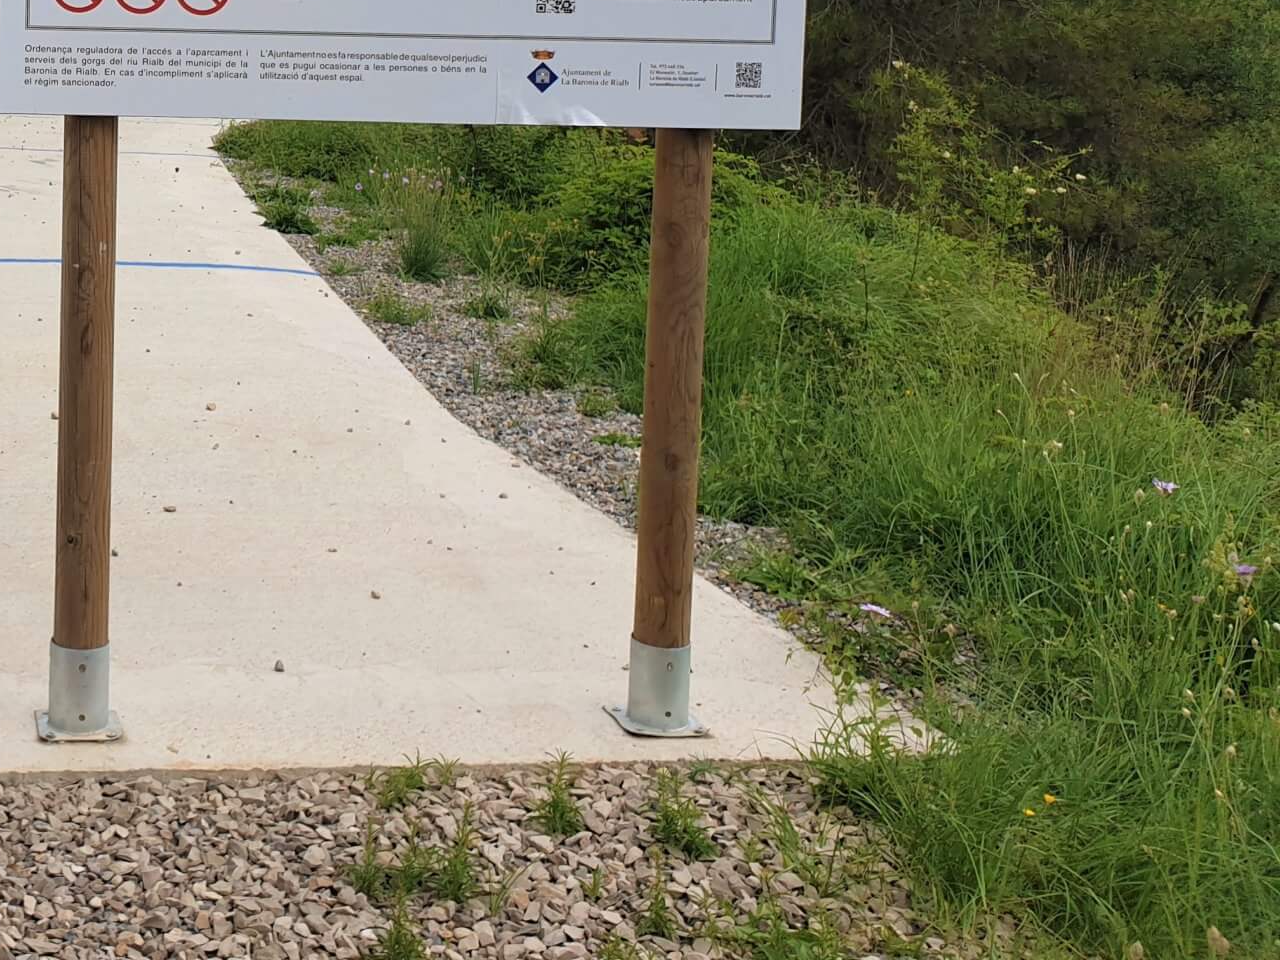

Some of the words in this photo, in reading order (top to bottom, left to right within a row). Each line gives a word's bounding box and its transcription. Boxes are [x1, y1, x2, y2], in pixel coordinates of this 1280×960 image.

[24, 43, 72, 55] Ordenança
[76, 45, 122, 56] reguladora
[126, 46, 138, 55] de
[24, 55, 55, 64] serveis
[59, 55, 77, 65] dels
[81, 57, 105, 67] gorgs
[109, 56, 122, 66] del
[126, 57, 137, 66] riu
[142, 57, 164, 66] Rialb
[168, 58, 181, 67] del
[185, 59, 221, 69] municipi
[225, 59, 236, 68] de
[240, 59, 248, 68] la
[259, 61, 276, 70] que
[278, 61, 289, 69] es
[292, 62, 316, 72] pugui
[319, 62, 360, 71] ocasionar
[372, 62, 385, 71] les
[388, 64, 428, 73] persones
[479, 64, 486, 74] la
[24, 65, 57, 75] Baronia
[61, 66, 72, 75] de
[104, 67, 115, 76] En
[119, 69, 134, 77] cas
[259, 71, 298, 80] utilització
[23, 76, 31, 85] el
[61, 78, 116, 87] sancionador.
